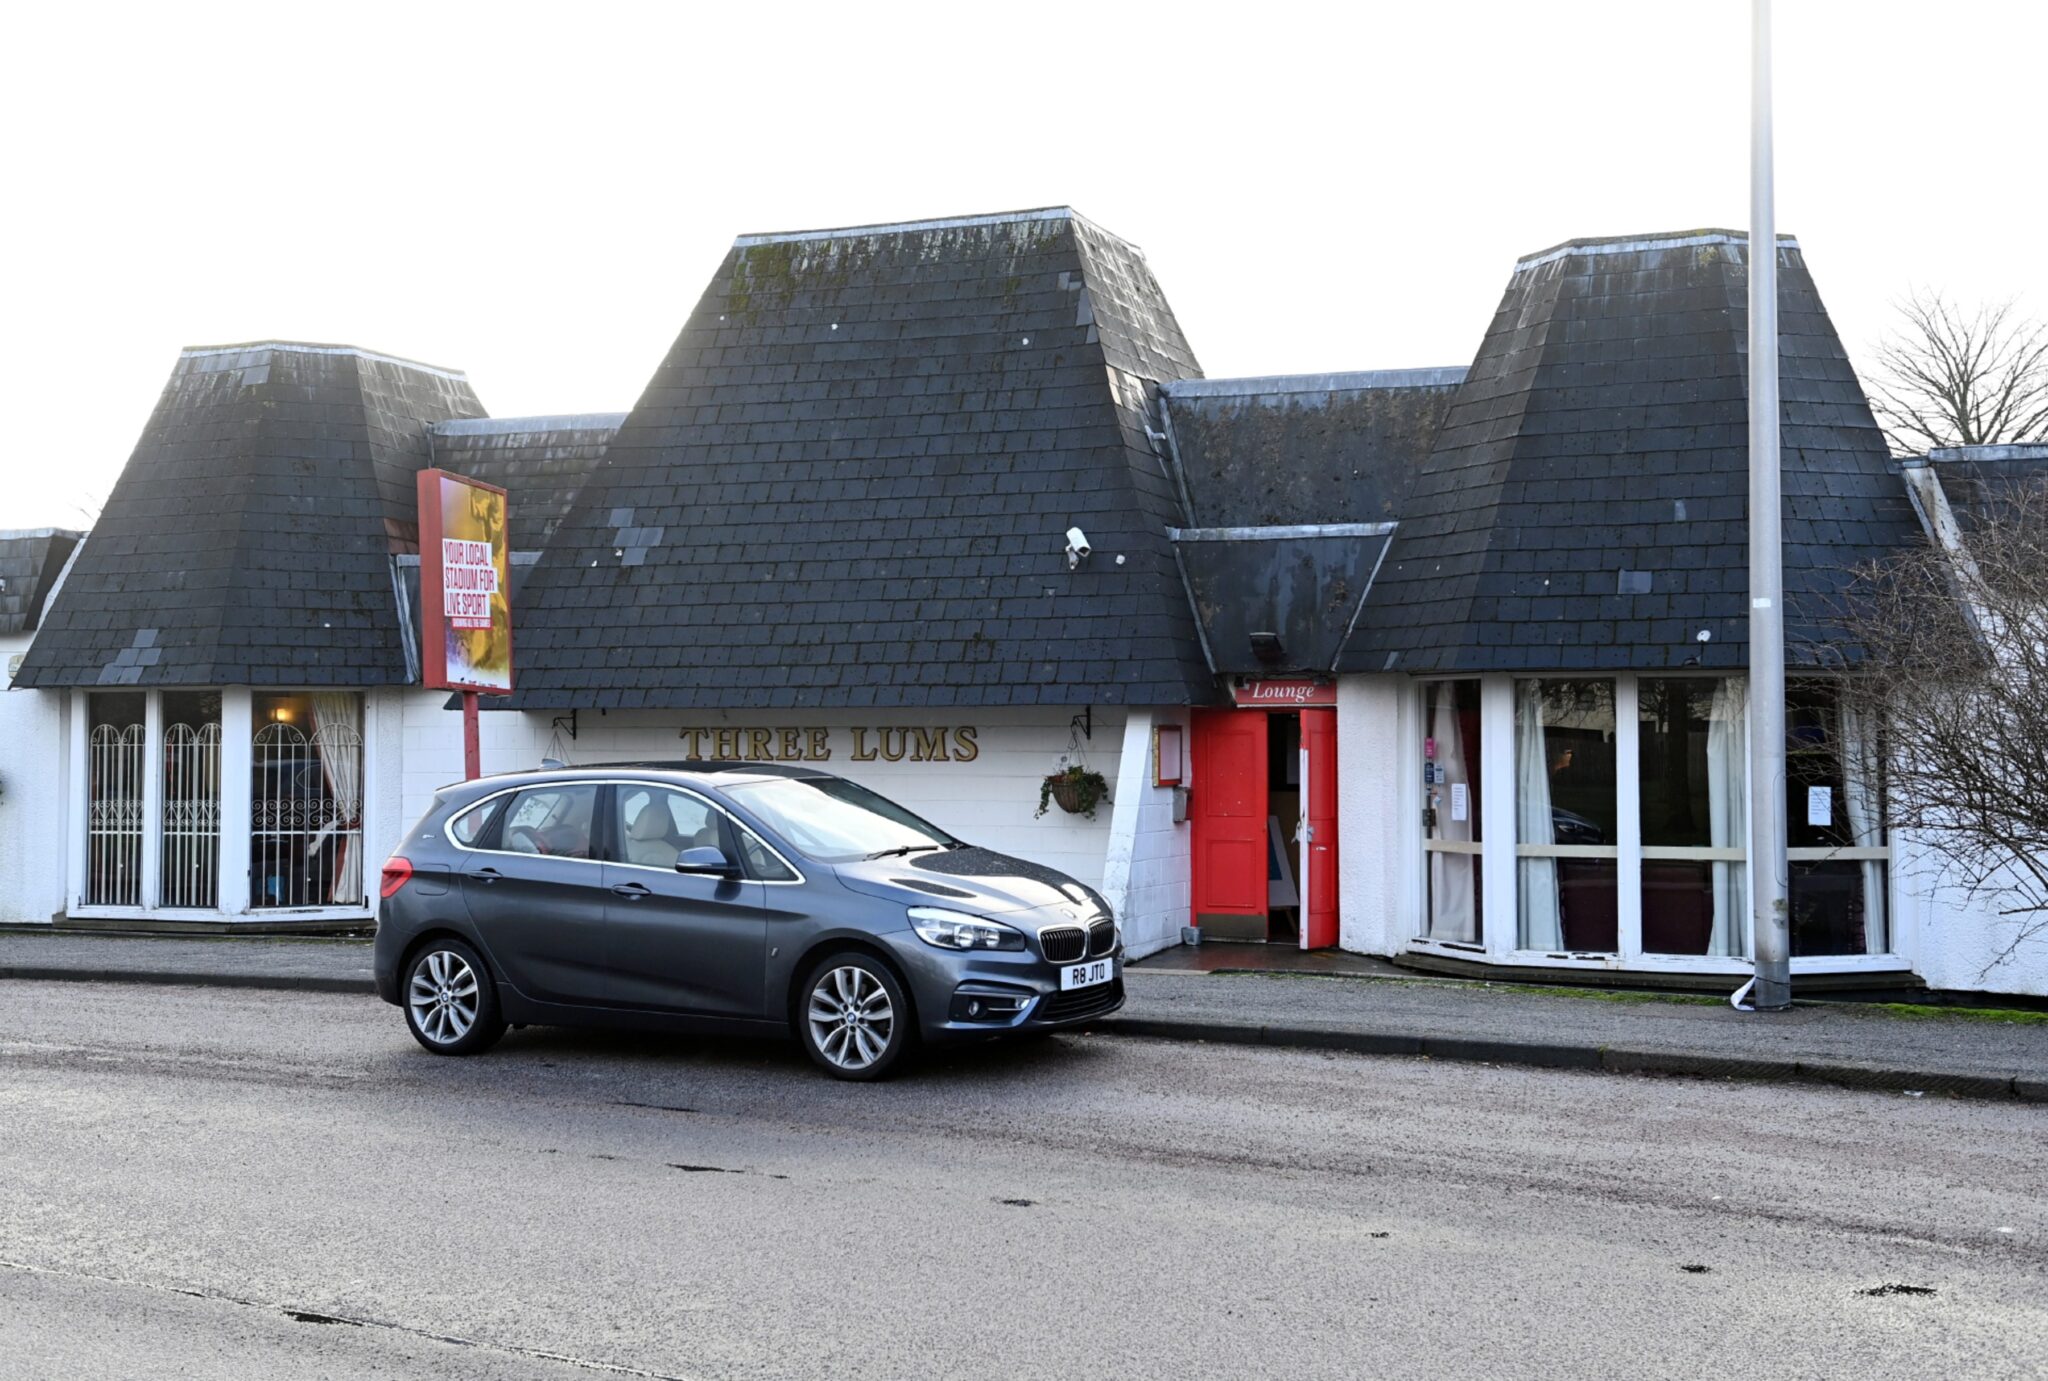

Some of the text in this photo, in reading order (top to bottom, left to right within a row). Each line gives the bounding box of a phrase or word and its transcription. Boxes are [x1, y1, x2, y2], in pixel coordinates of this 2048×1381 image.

[444, 541, 488, 566] YOUR LOCAL
[445, 566, 494, 592] STADIUM FOR
[446, 592, 486, 616] LIVE SPORT
[1252, 682, 1315, 703] Lounge
[679, 726, 979, 762] THREE LUMS
[1072, 963, 1105, 986] R8 JTO
